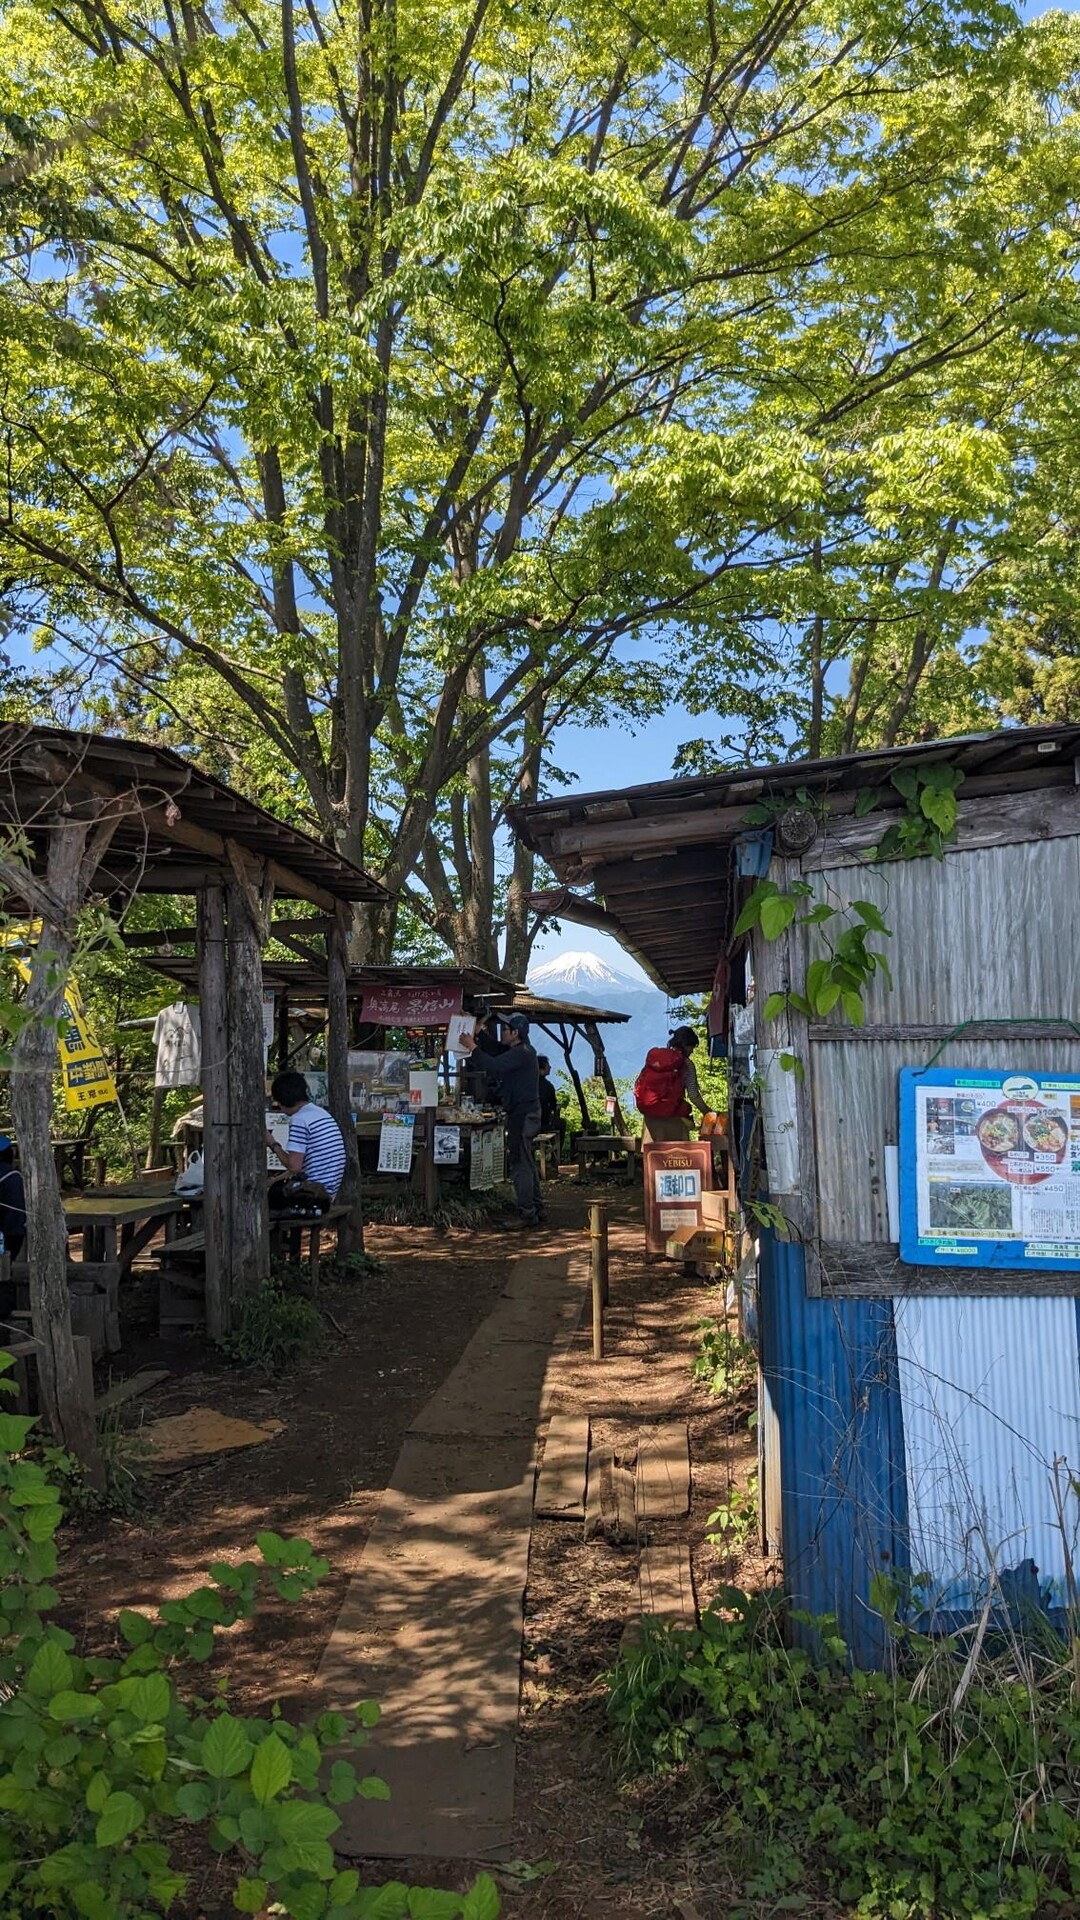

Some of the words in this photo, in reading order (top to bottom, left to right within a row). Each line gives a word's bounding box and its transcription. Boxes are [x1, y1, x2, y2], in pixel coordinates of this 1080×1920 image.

[1035, 1153, 1056, 1161] ¥350
[662, 1160, 693, 1168] YEBISU
[660, 1175, 696, 1197] 返却口
